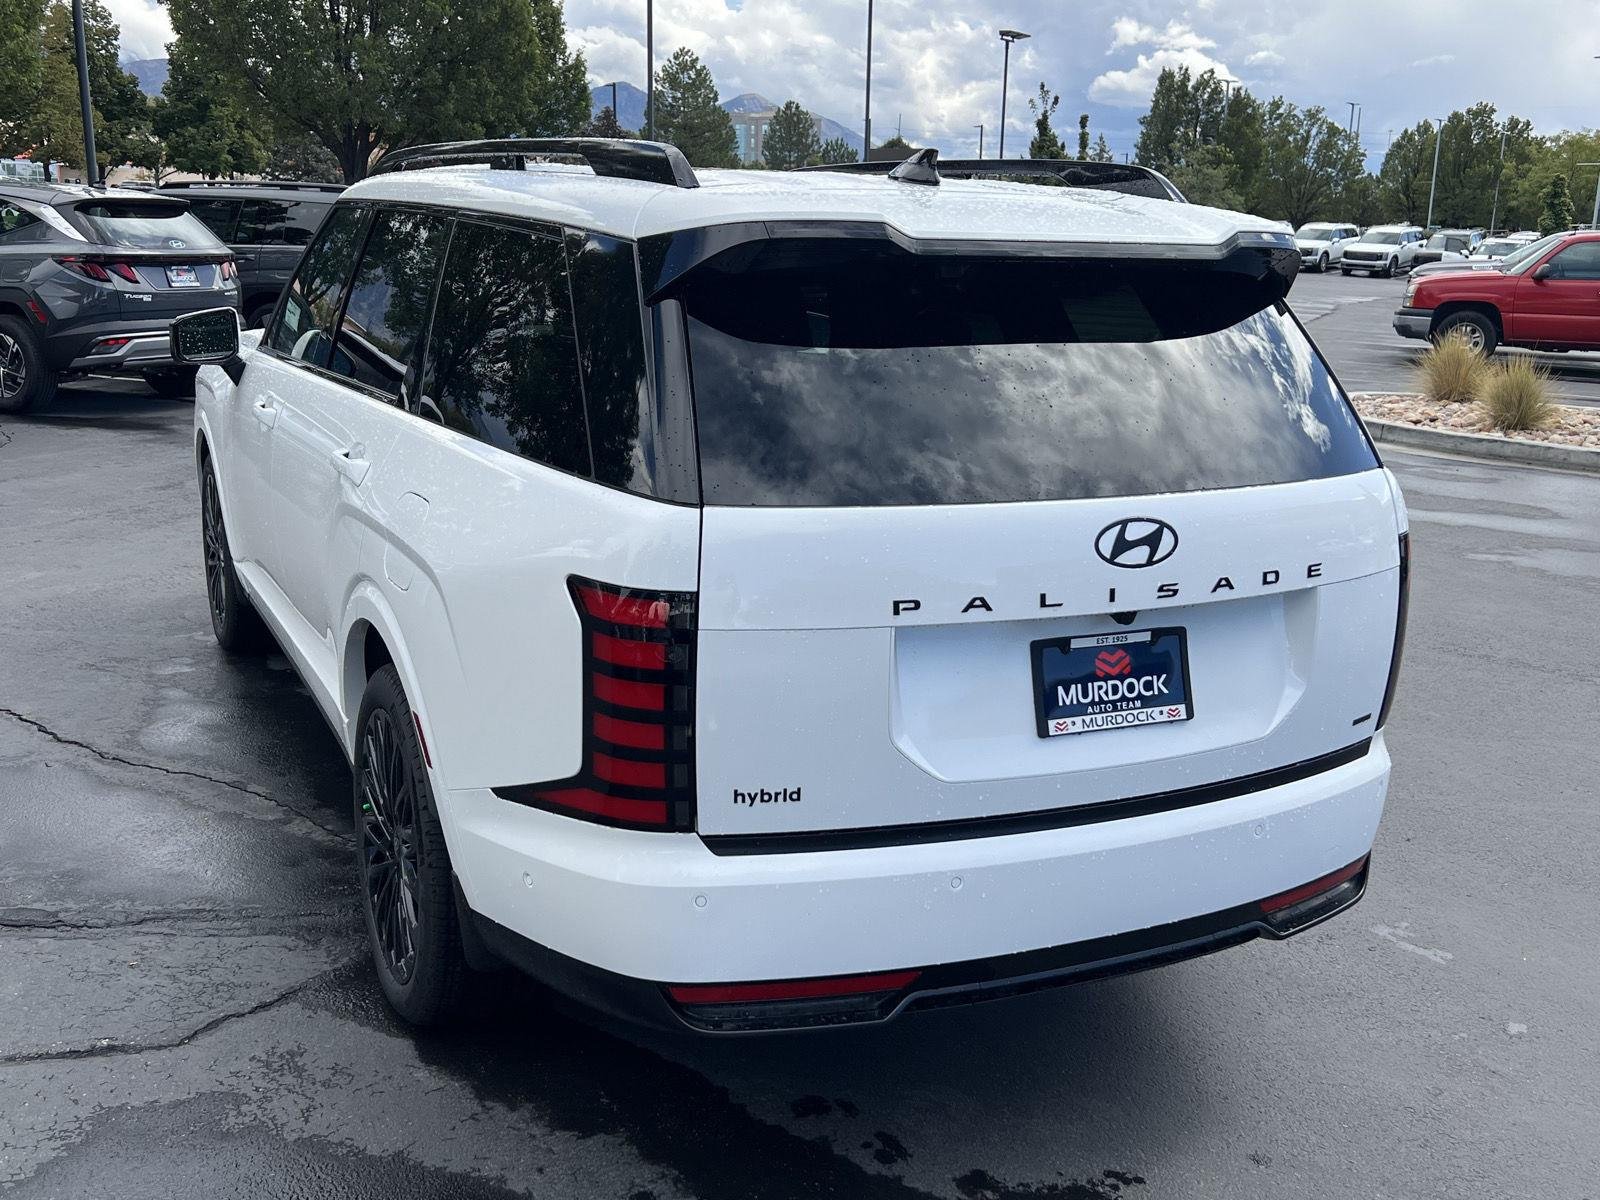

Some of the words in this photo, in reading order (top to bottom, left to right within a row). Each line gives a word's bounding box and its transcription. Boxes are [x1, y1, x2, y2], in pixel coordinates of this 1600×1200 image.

[893, 562, 1322, 616] PALISADE
[1096, 636, 1110, 645] EST.
[1112, 635, 1128, 644] 1925
[1057, 673, 1169, 706] MURDOCK
[1087, 703, 1113, 714] AUTO
[1117, 700, 1142, 711] TEAM
[1081, 709, 1157, 729] MURDOCK
[733, 786, 802, 807] hybrid
